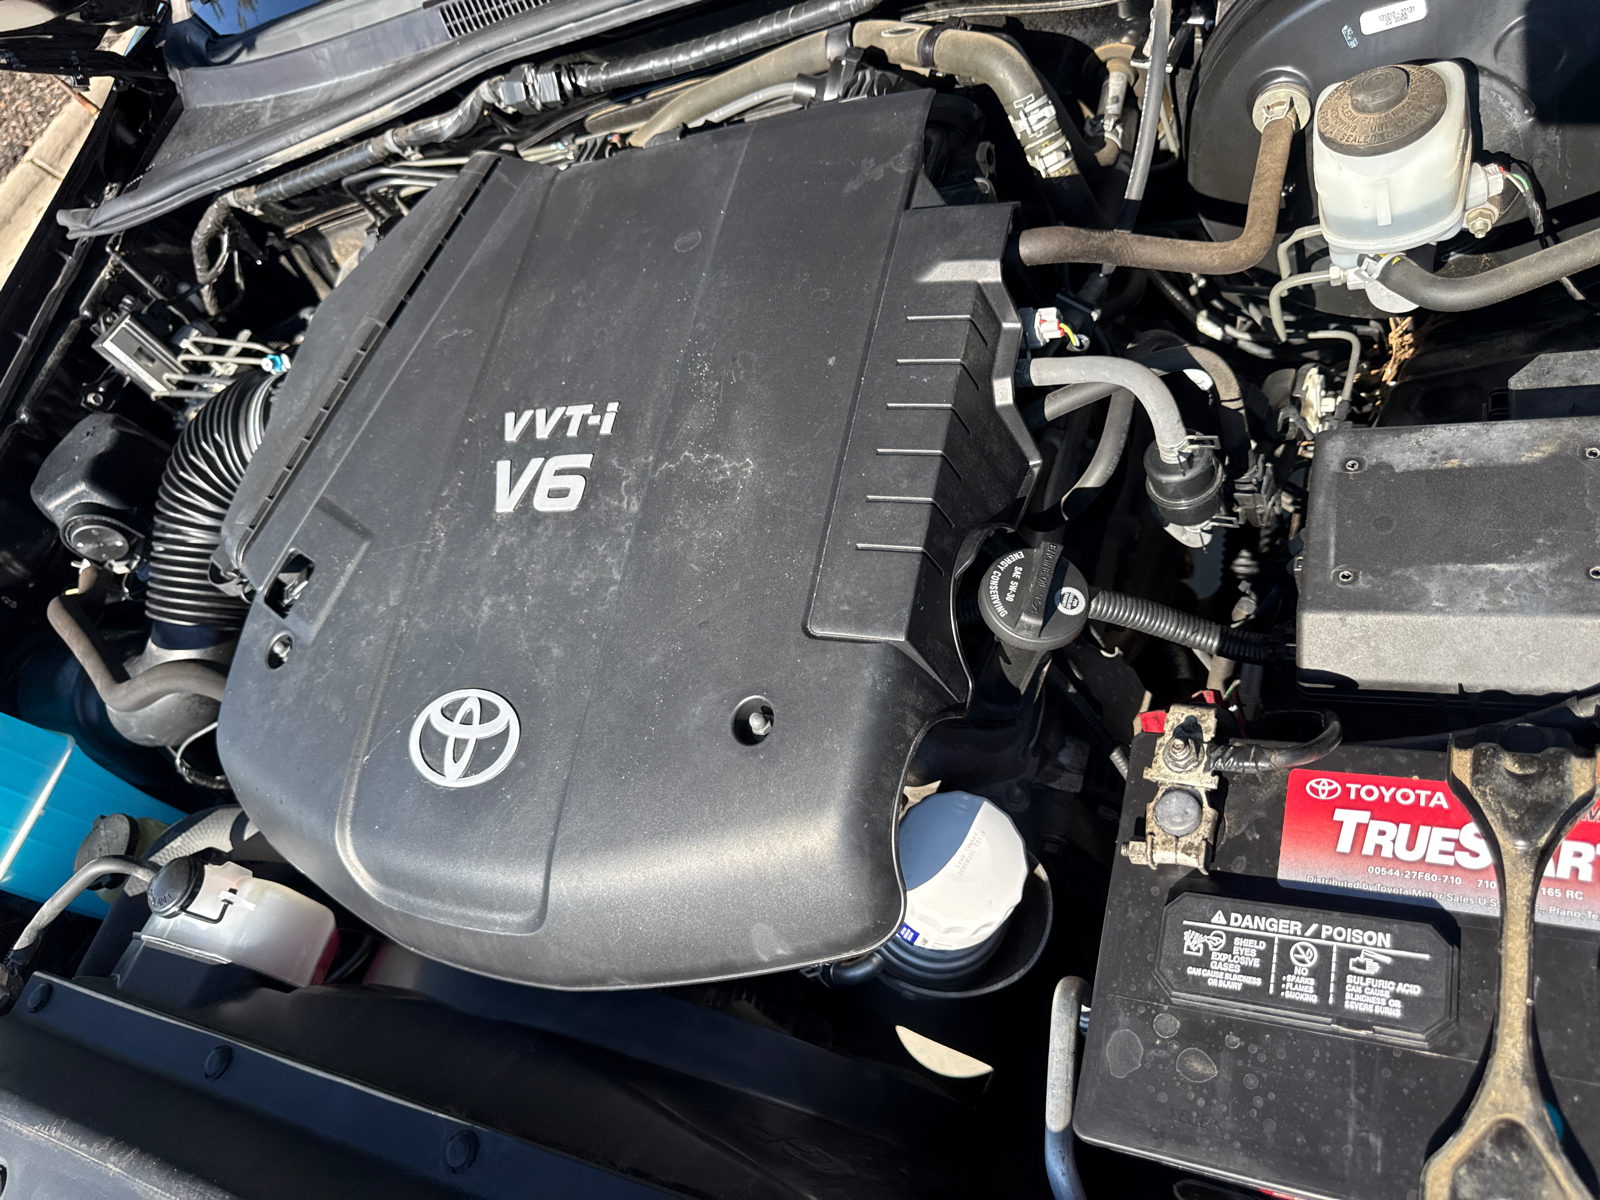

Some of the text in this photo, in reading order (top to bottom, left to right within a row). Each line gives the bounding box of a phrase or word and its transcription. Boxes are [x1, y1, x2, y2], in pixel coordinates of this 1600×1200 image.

[1340, 132, 1377, 144] SEALED
[504, 401, 620, 442] VVT-i
[495, 453, 594, 513] V6
[989, 550, 1025, 618] ENERGY CONSERVING
[1005, 565, 1023, 602] SAE 5W-30
[1345, 782, 1449, 809] TOYOTA
[955, 832, 979, 869] Leak Tested
[1367, 865, 1584, 901] 00544-27F60-710 710 165 RC
[1306, 875, 1359, 890] Distributed
[1363, 881, 1373, 892] by
[1376, 883, 1409, 897] Toyota
[1411, 887, 1443, 901] Motor
[1446, 893, 1475, 905] Sales
[1549, 905, 1584, 919] Plano,
[1586, 910, 1600, 921] Te
[1229, 912, 1302, 936] DANGER
[1321, 924, 1391, 948] POISON
[1232, 945, 1257, 958] EYES
[1233, 936, 1267, 950] SHIELD
[1209, 960, 1241, 974] GASES
[1210, 951, 1261, 968] EXPLOSIVE
[1186, 966, 1262, 986] CAN CAUSE BLINDNESS
[1286, 974, 1315, 986] SPARKS
[1293, 966, 1308, 976] NO
[1207, 977, 1218, 987] OR
[1286, 982, 1314, 994] FLAMES
[1345, 984, 1391, 998] CAN CAUSE
[1346, 974, 1422, 997] SULFURIC ACID
[1284, 990, 1318, 1004] SMOKING
[1345, 992, 1402, 1009] BLINDNESS OR
[1344, 1000, 1402, 1019] SEVERE BURNS
